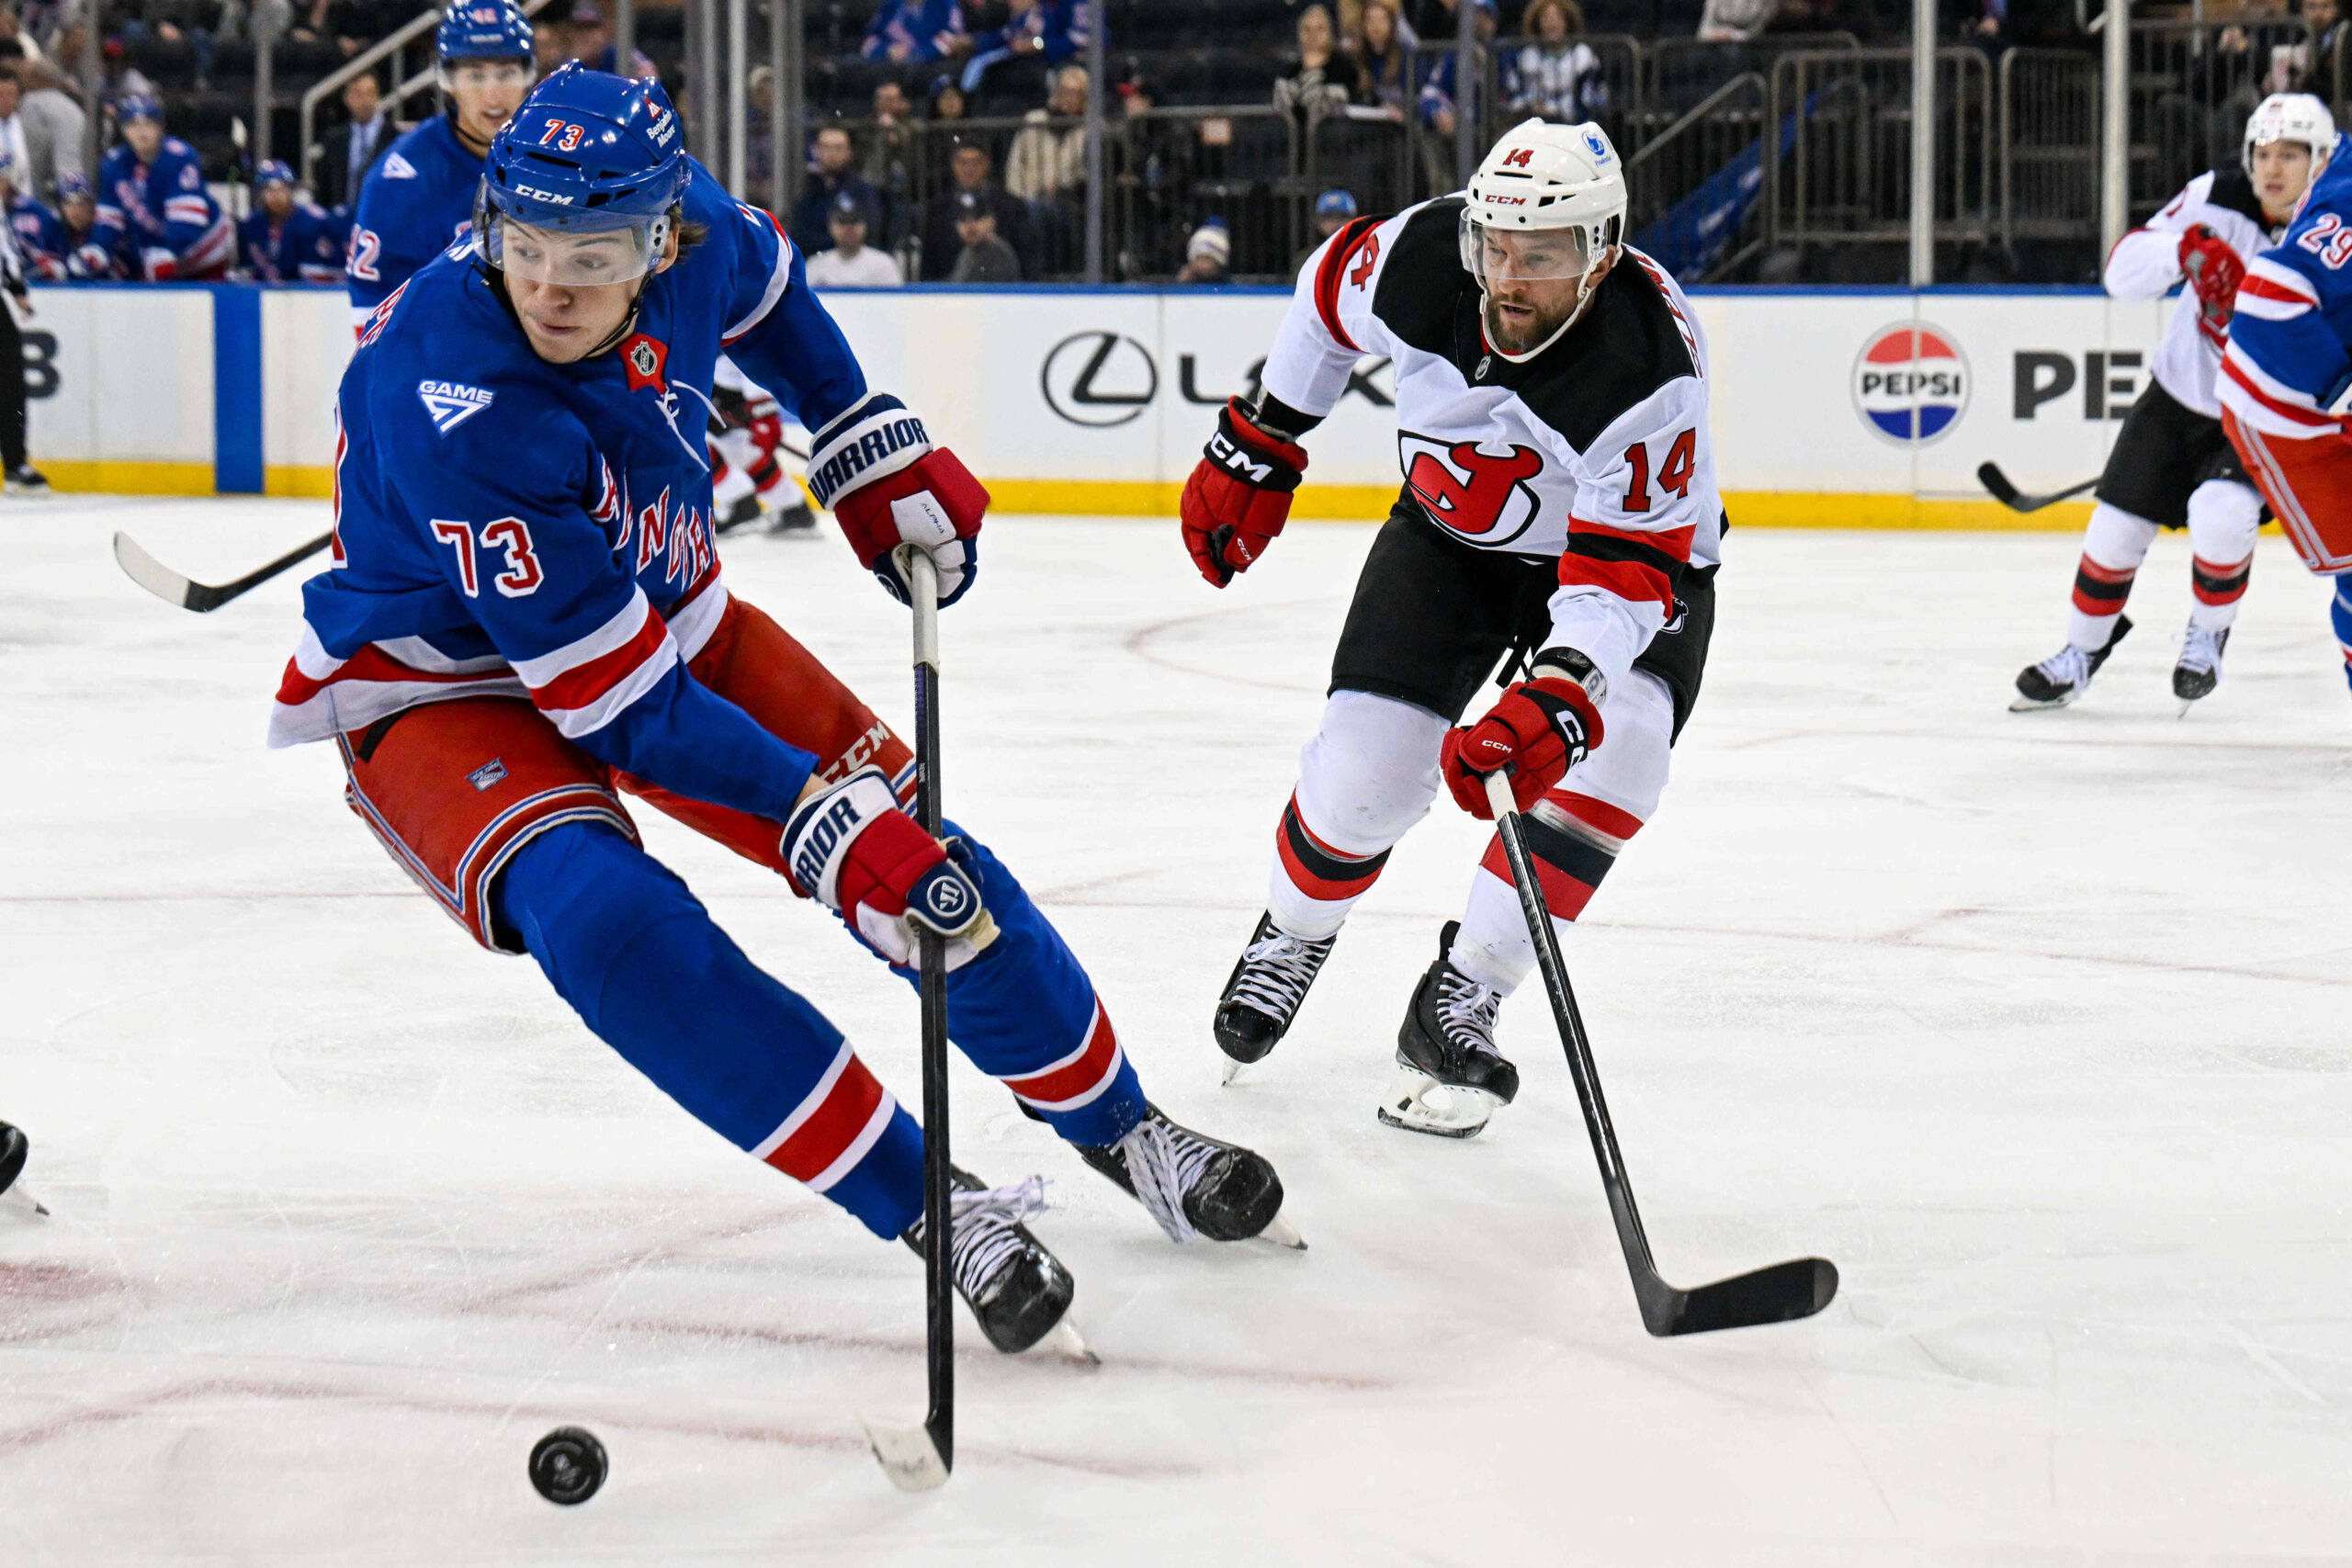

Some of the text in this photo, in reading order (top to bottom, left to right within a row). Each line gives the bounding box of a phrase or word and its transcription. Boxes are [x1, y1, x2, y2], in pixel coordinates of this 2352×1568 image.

[538, 118, 585, 152] 73
[1502, 148, 1535, 168] 14
[514, 184, 574, 206] CCM
[1485, 194, 1527, 206] CCM
[2298, 212, 2352, 271] 29
[1351, 233, 1380, 292] 4
[419, 380, 493, 404] GAME
[1862, 372, 1961, 396] PEPSI
[2014, 350, 2143, 420] PE
[808, 418, 929, 510] WARRIOR
[1210, 432, 1272, 482] CM
[1623, 426, 1696, 513] 14
[922, 502, 945, 534] ALPHA
[430, 516, 544, 599] 73
[1237, 537, 1253, 561] CCM
[1482, 739, 1512, 754] CCM
